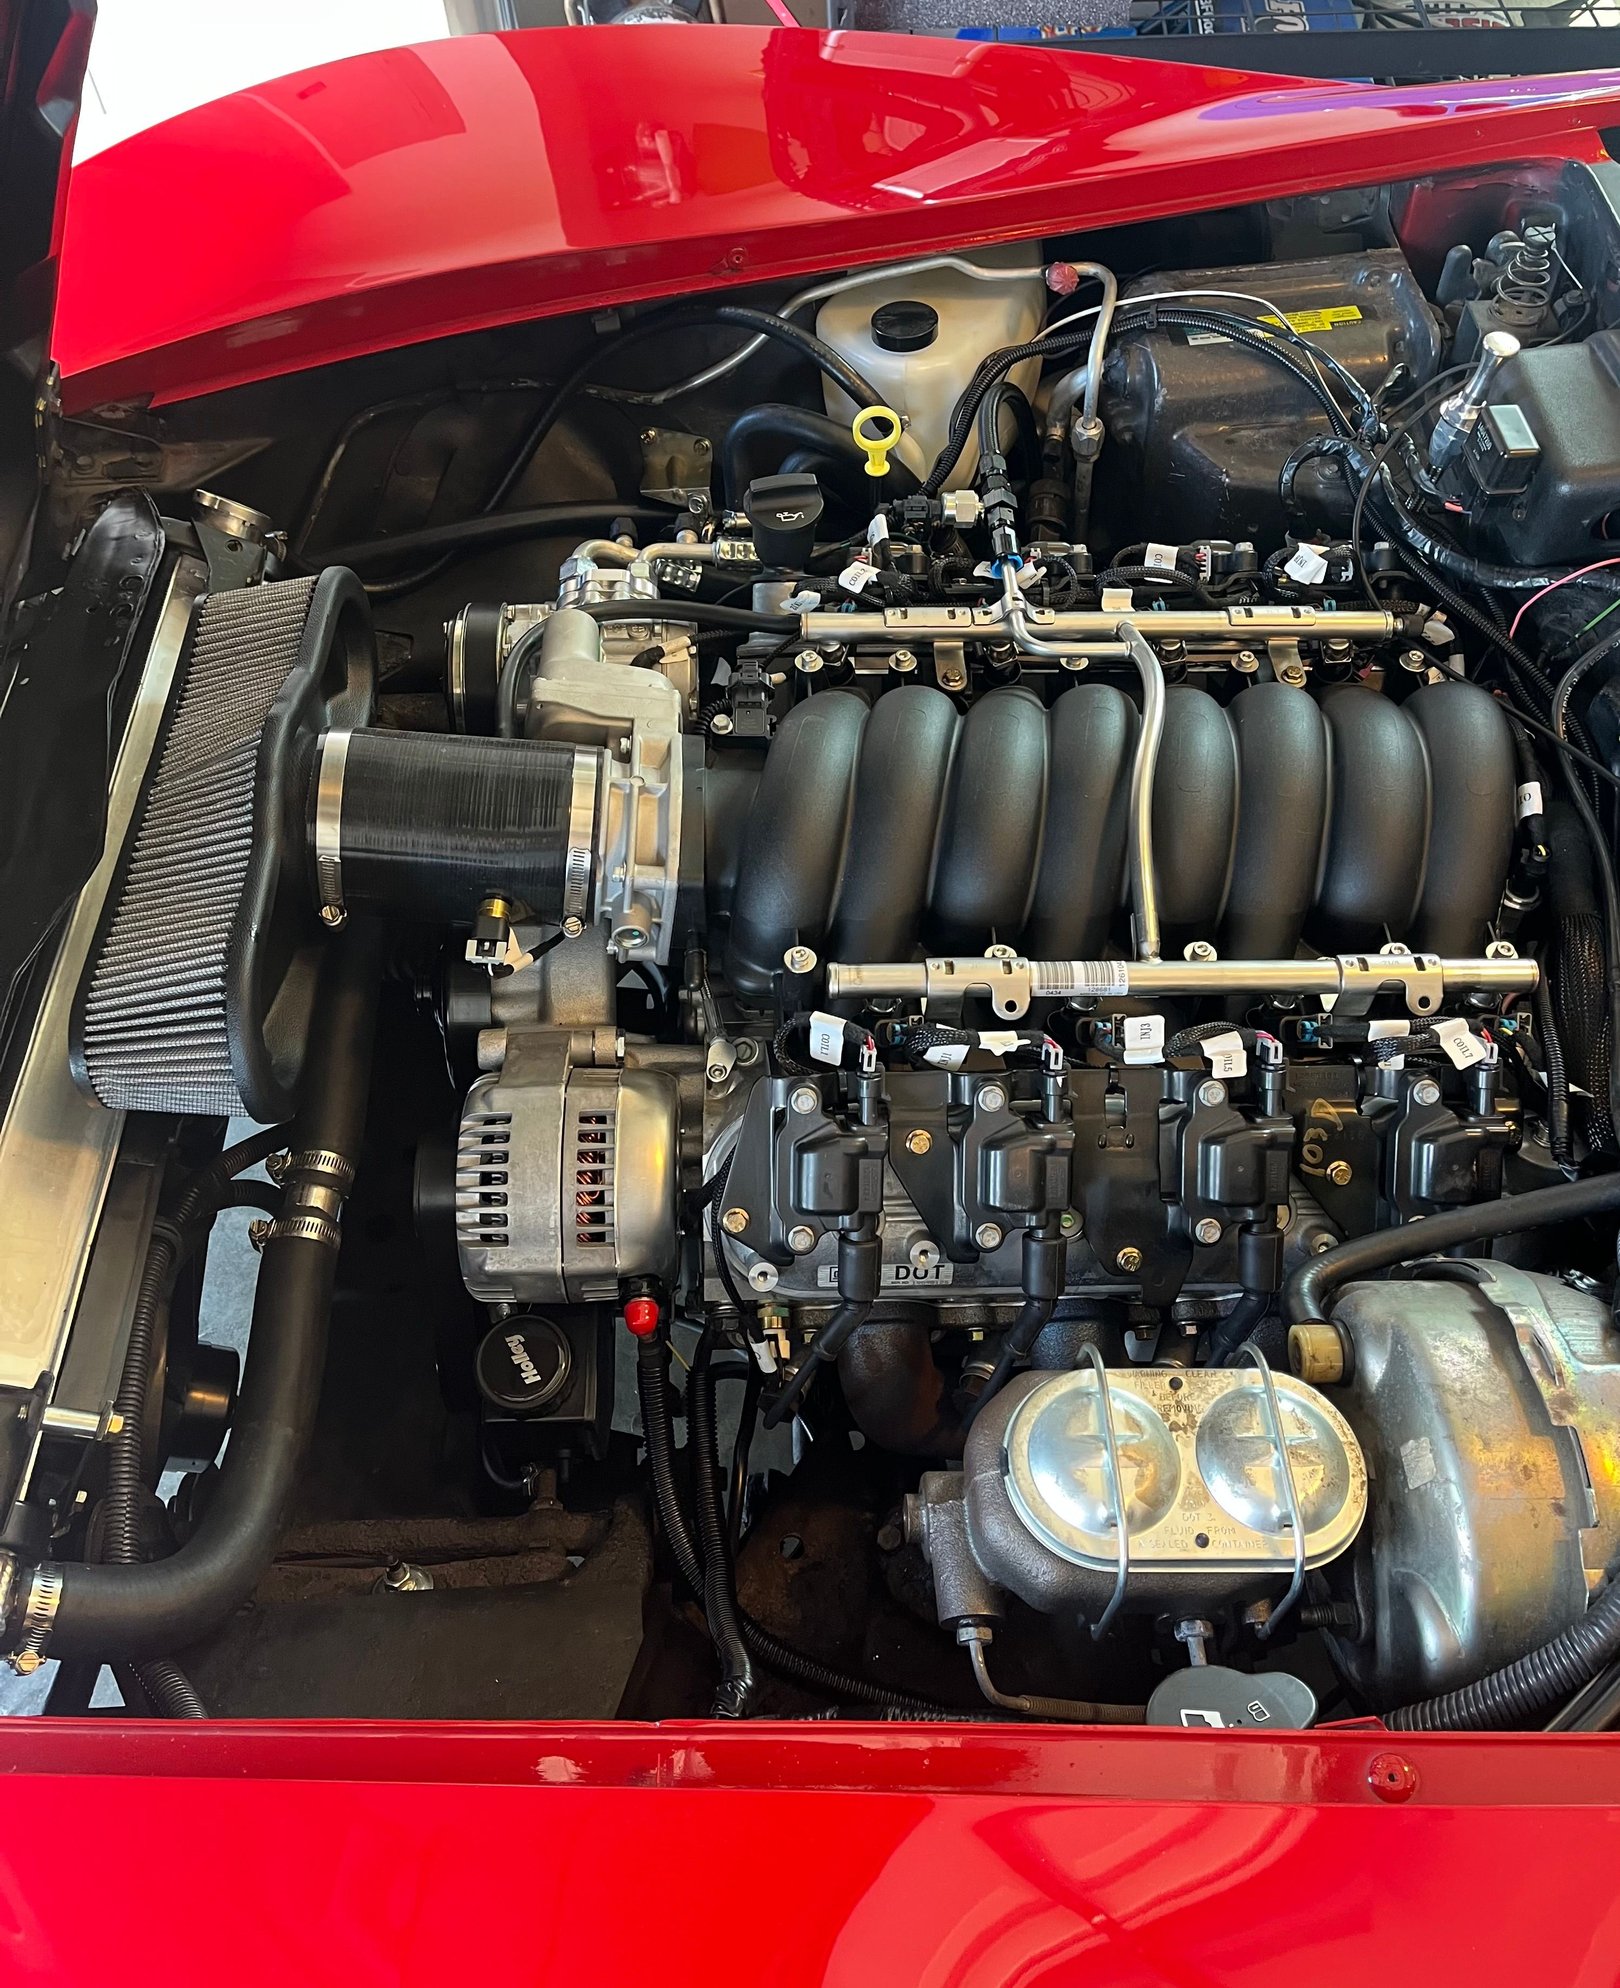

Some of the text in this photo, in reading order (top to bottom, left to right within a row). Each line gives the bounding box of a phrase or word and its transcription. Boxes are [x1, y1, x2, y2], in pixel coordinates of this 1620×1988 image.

[848, 567, 867, 587] COIL2
[1140, 1022, 1151, 1041] INJ3
[820, 1033, 831, 1056] COIL1
[1453, 1037, 1474, 1059] COIL7
[504, 1334, 542, 1385] Holley
